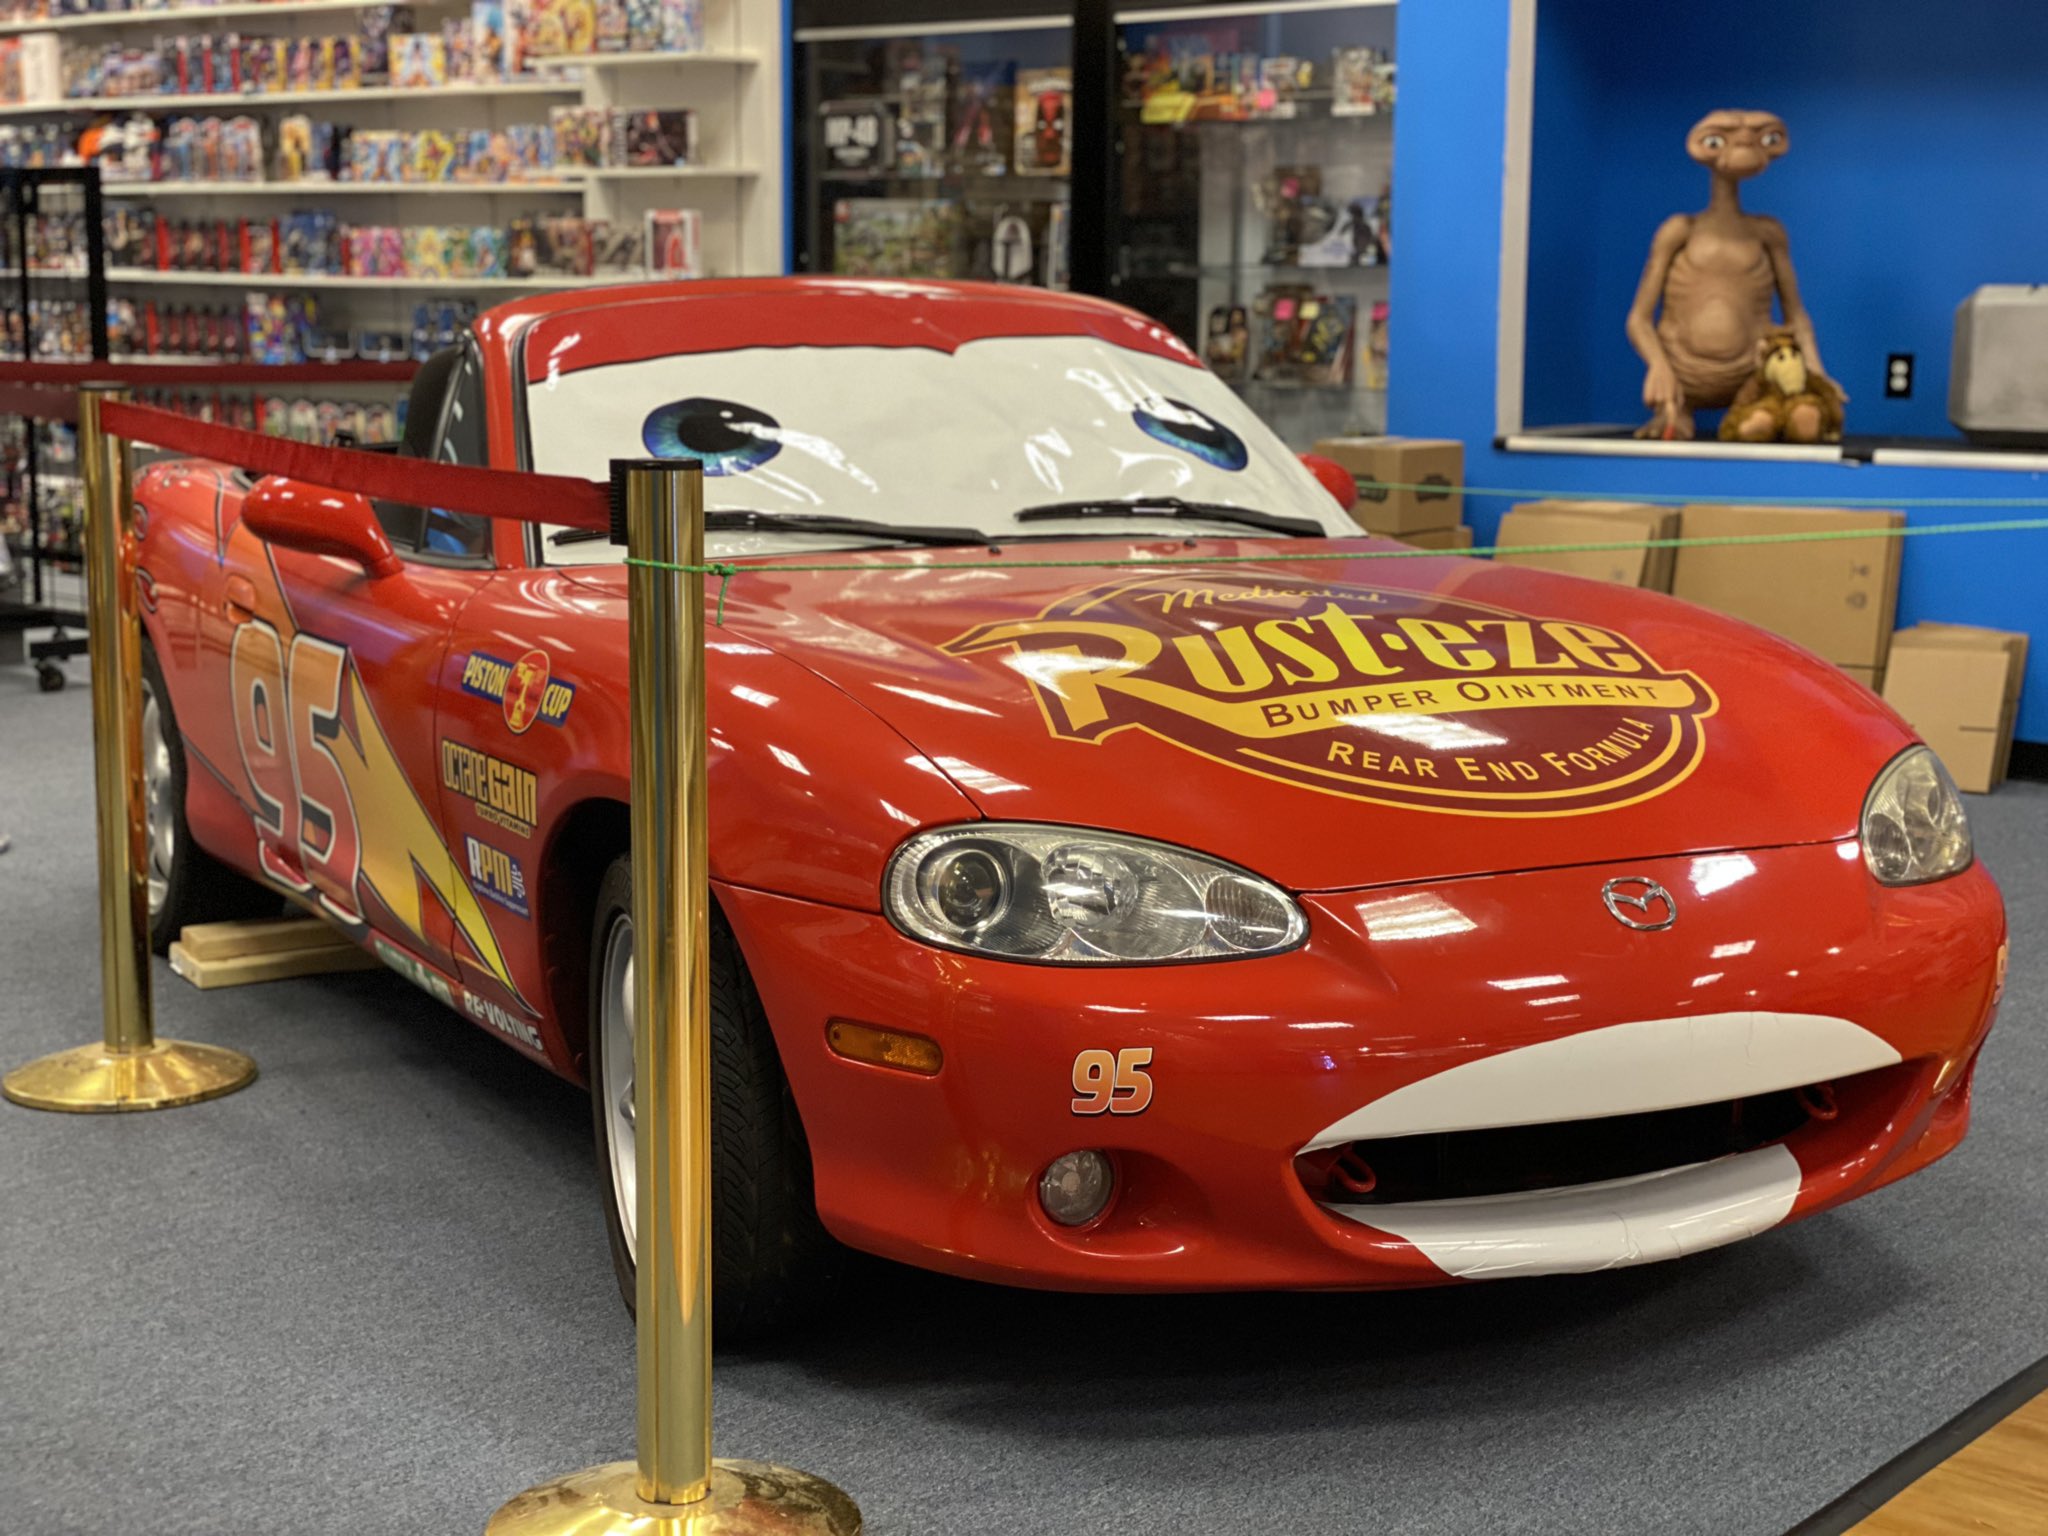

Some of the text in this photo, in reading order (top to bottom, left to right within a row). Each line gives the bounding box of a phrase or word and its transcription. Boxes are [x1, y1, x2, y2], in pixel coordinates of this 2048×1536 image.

[462, 655, 573, 719] PISTON CUP
[1260, 680, 1658, 728] BUMPER OINTMENT
[230, 620, 363, 925] 95
[1327, 716, 1655, 782] REAR END FORMULA
[466, 836, 513, 897] RPM
[1071, 1047, 1153, 1116] 95
